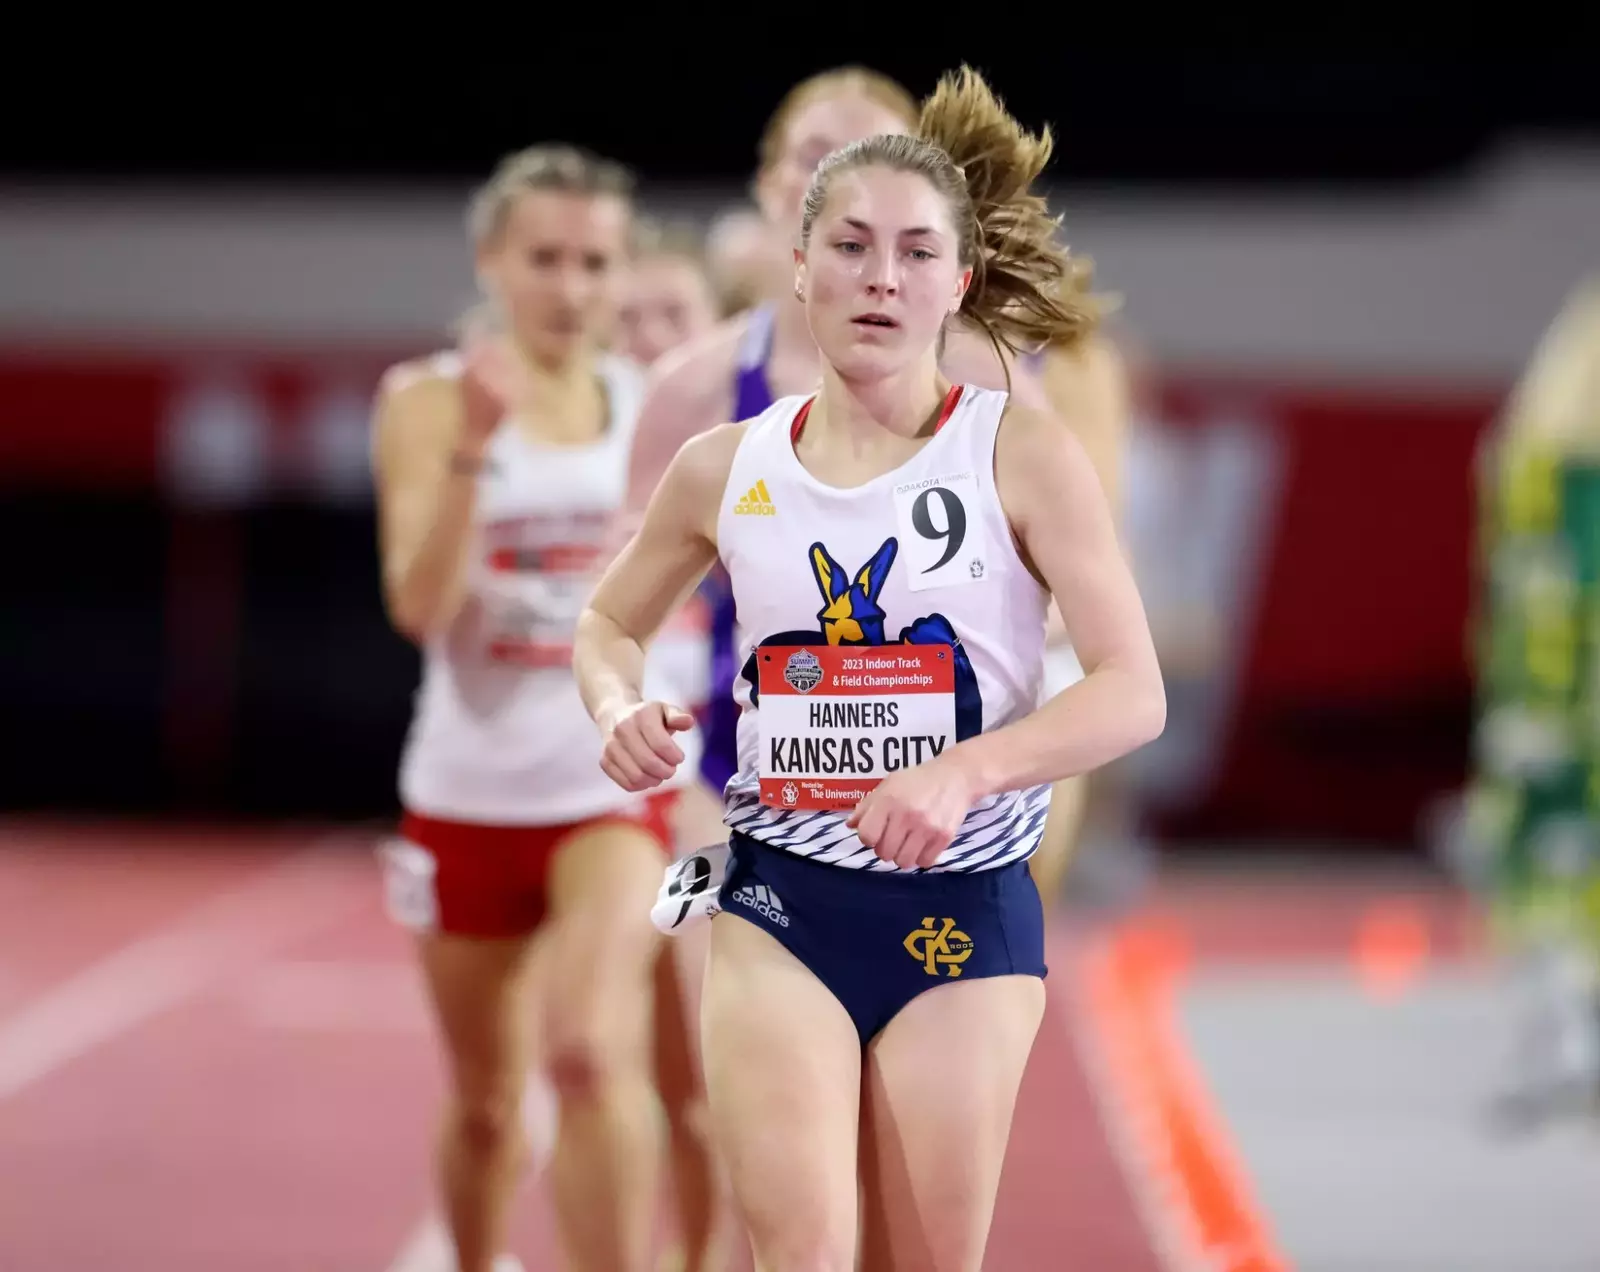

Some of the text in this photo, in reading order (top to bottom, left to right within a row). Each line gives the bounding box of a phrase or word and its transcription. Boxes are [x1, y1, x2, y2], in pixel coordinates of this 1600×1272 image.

[904, 477, 940, 493] DAKOTA
[733, 504, 776, 516] adidas
[911, 487, 967, 575] 9
[842, 657, 921, 670] 2023 Indoor Track
[832, 673, 933, 687] & Field Championships
[809, 702, 899, 728] HANNERS
[771, 735, 946, 774] KANSAS CITY
[810, 789, 824, 799] The
[825, 788, 865, 801] University
[732, 890, 790, 928] adidas
